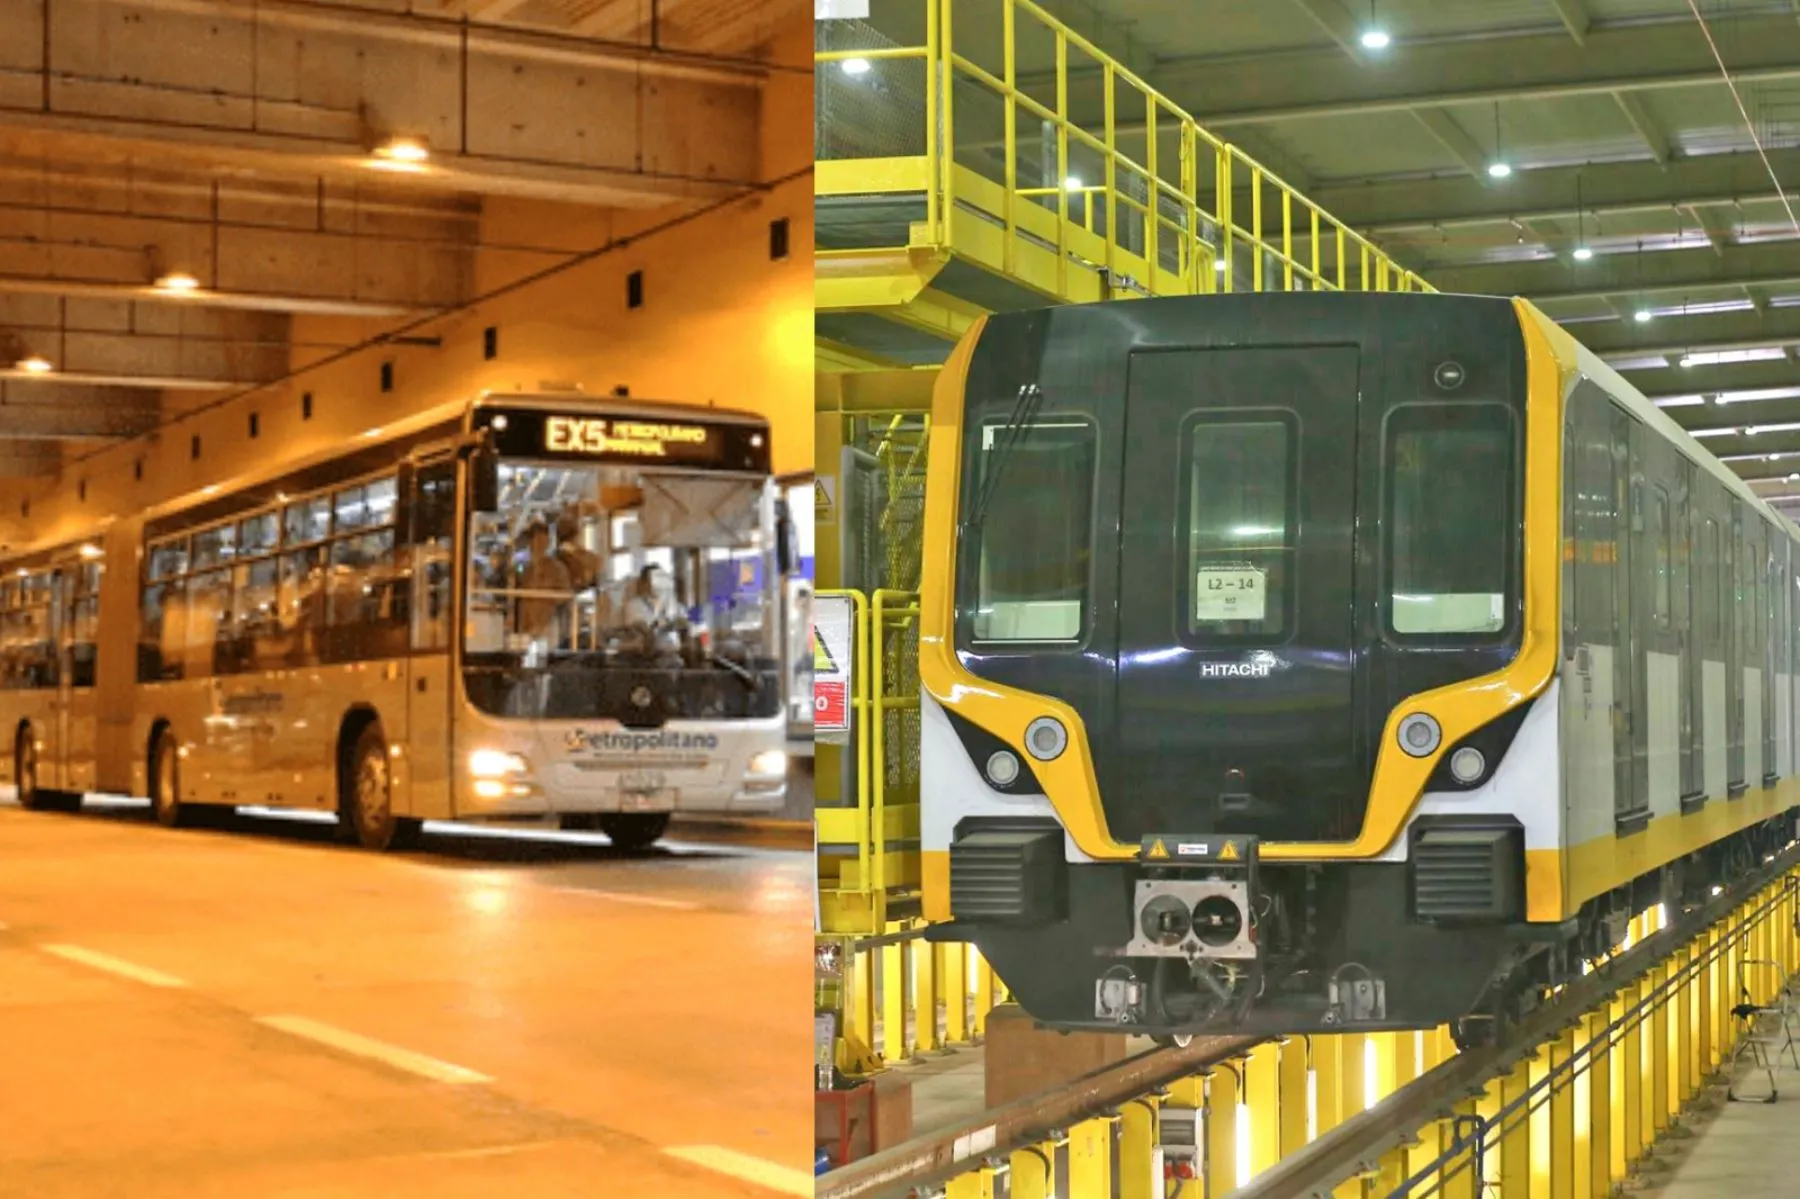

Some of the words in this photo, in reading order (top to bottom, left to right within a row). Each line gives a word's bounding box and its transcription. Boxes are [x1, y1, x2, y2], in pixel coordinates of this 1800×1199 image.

[546, 416, 606, 451] EX5
[1208, 578, 1222, 590] L2
[1238, 578, 1254, 590] 14
[1202, 664, 1269, 676] HITACHI
